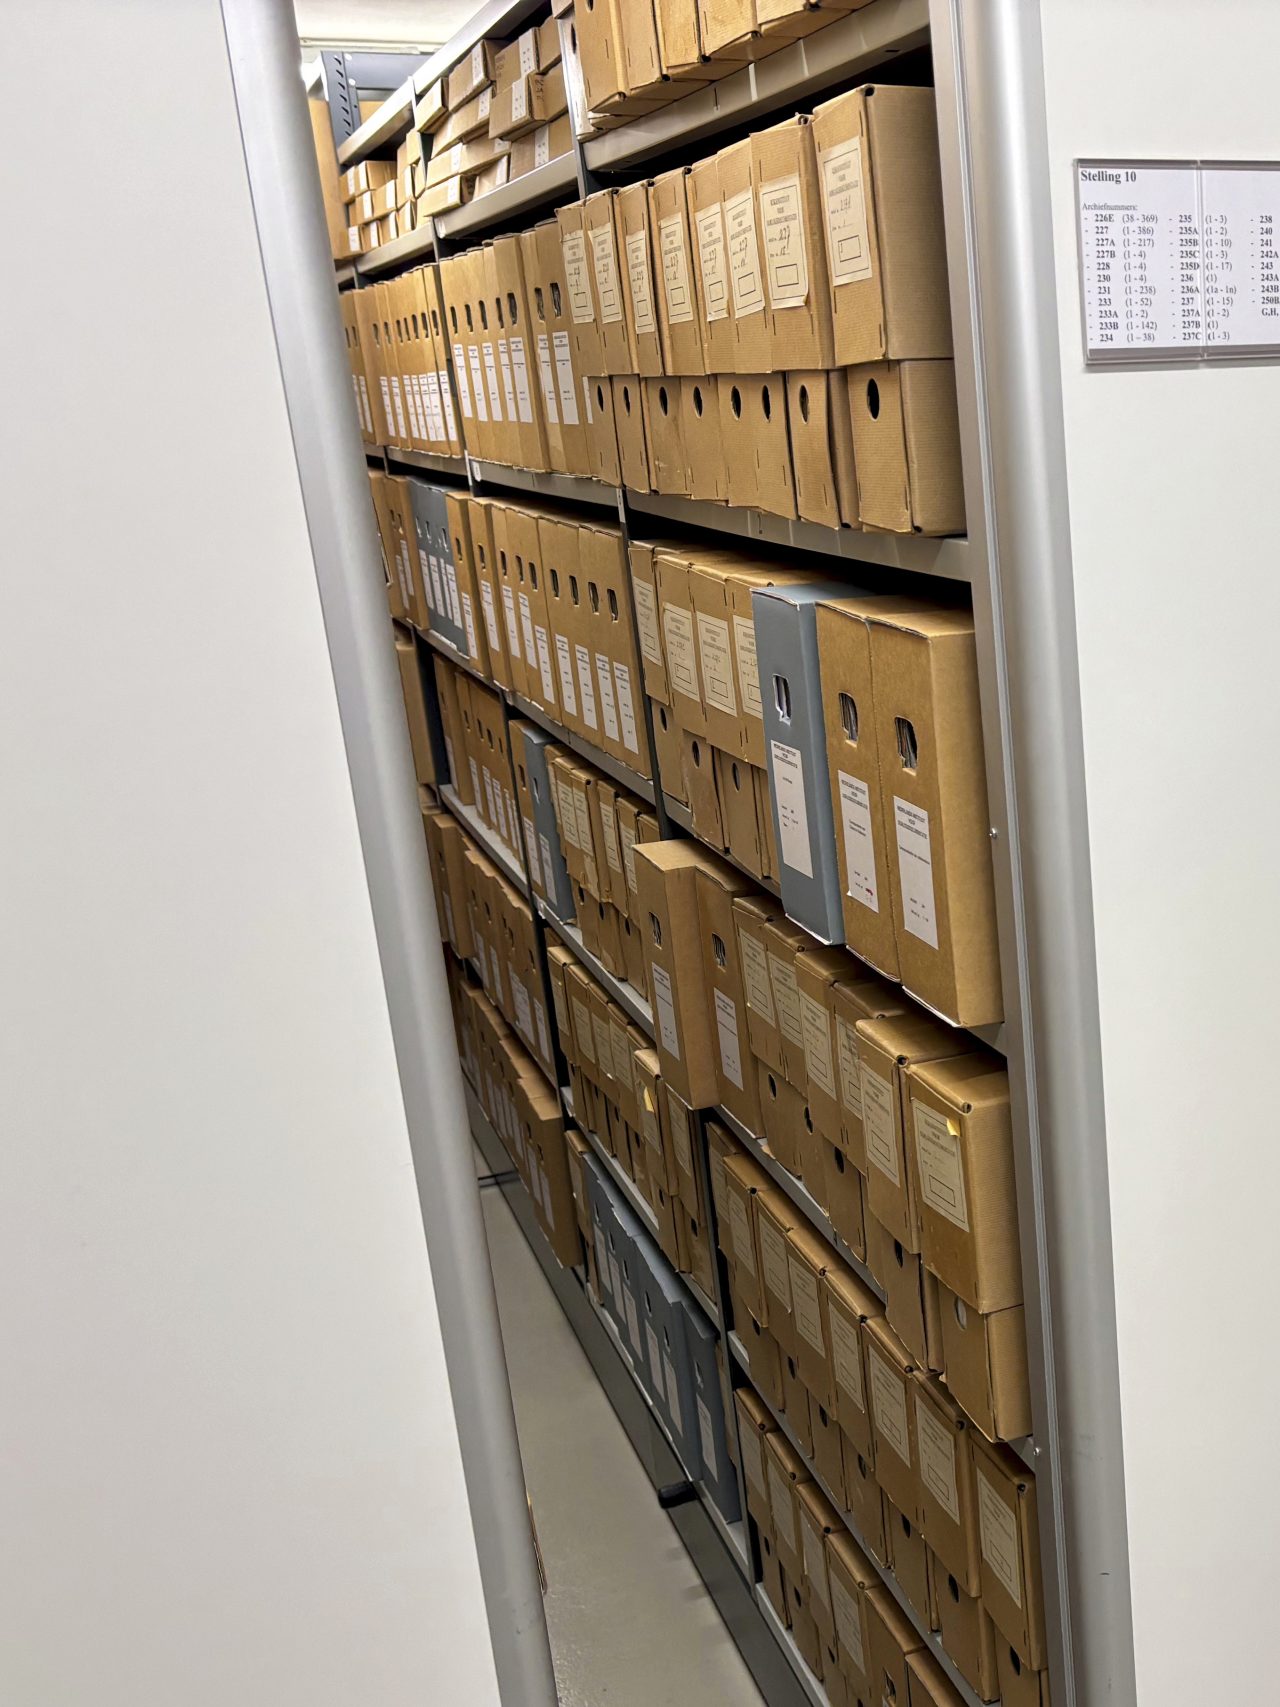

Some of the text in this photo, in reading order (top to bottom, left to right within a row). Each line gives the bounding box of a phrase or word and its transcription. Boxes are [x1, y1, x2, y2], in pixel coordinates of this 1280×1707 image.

[1081, 170, 1137, 184] Stelling 10
[1095, 214, 1114, 222] 226E
[1179, 215, 1192, 223] 235
[1205, 215, 1212, 224] (1
[1220, 214, 1227, 225] 3)
[1096, 226, 1108, 234] 227
[1123, 226, 1129, 236] (1
[1205, 227, 1212, 236] (1
[1220, 226, 1227, 236] 2)
[1096, 238, 1115, 246] 227A
[1123, 238, 1130, 248] (1
[1206, 239, 1212, 248] (1
[1260, 239, 1272, 247] 241
[1096, 250, 1116, 258] 227B
[1124, 250, 1130, 260] (1
[1138, 250, 1146, 260] 4)
[1206, 250, 1212, 260] (1
[1221, 250, 1227, 259] 3)
[1097, 262, 1110, 270] 228
[1124, 262, 1130, 272] (1
[1138, 262, 1146, 272] 4)
[1180, 262, 1200, 270] 235D
[1206, 262, 1212, 272] (1
[1097, 274, 1111, 282] 230
[1124, 274, 1131, 284] (1
[1139, 274, 1146, 284] 4)
[1181, 274, 1193, 282] 236
[1125, 286, 1132, 295] (1
[1098, 298, 1111, 306] 233
[1126, 298, 1132, 308] (1
[1182, 297, 1194, 305] 237
[1207, 297, 1214, 307] (1
[1099, 310, 1118, 318] 233A
[1126, 310, 1132, 319] (1
[1141, 310, 1148, 319] 2)
[1182, 309, 1200, 317] 237A
[1207, 309, 1214, 319] (1
[1222, 309, 1229, 318] 2)
[1100, 322, 1119, 330] 233B
[1126, 322, 1133, 331] (1
[1182, 321, 1200, 329] 237B
[1100, 334, 1113, 342] 234
[1127, 333, 1134, 343] (1
[1182, 332, 1201, 340] 237C
[1208, 332, 1215, 341] (1
[1222, 332, 1230, 341] 3)
